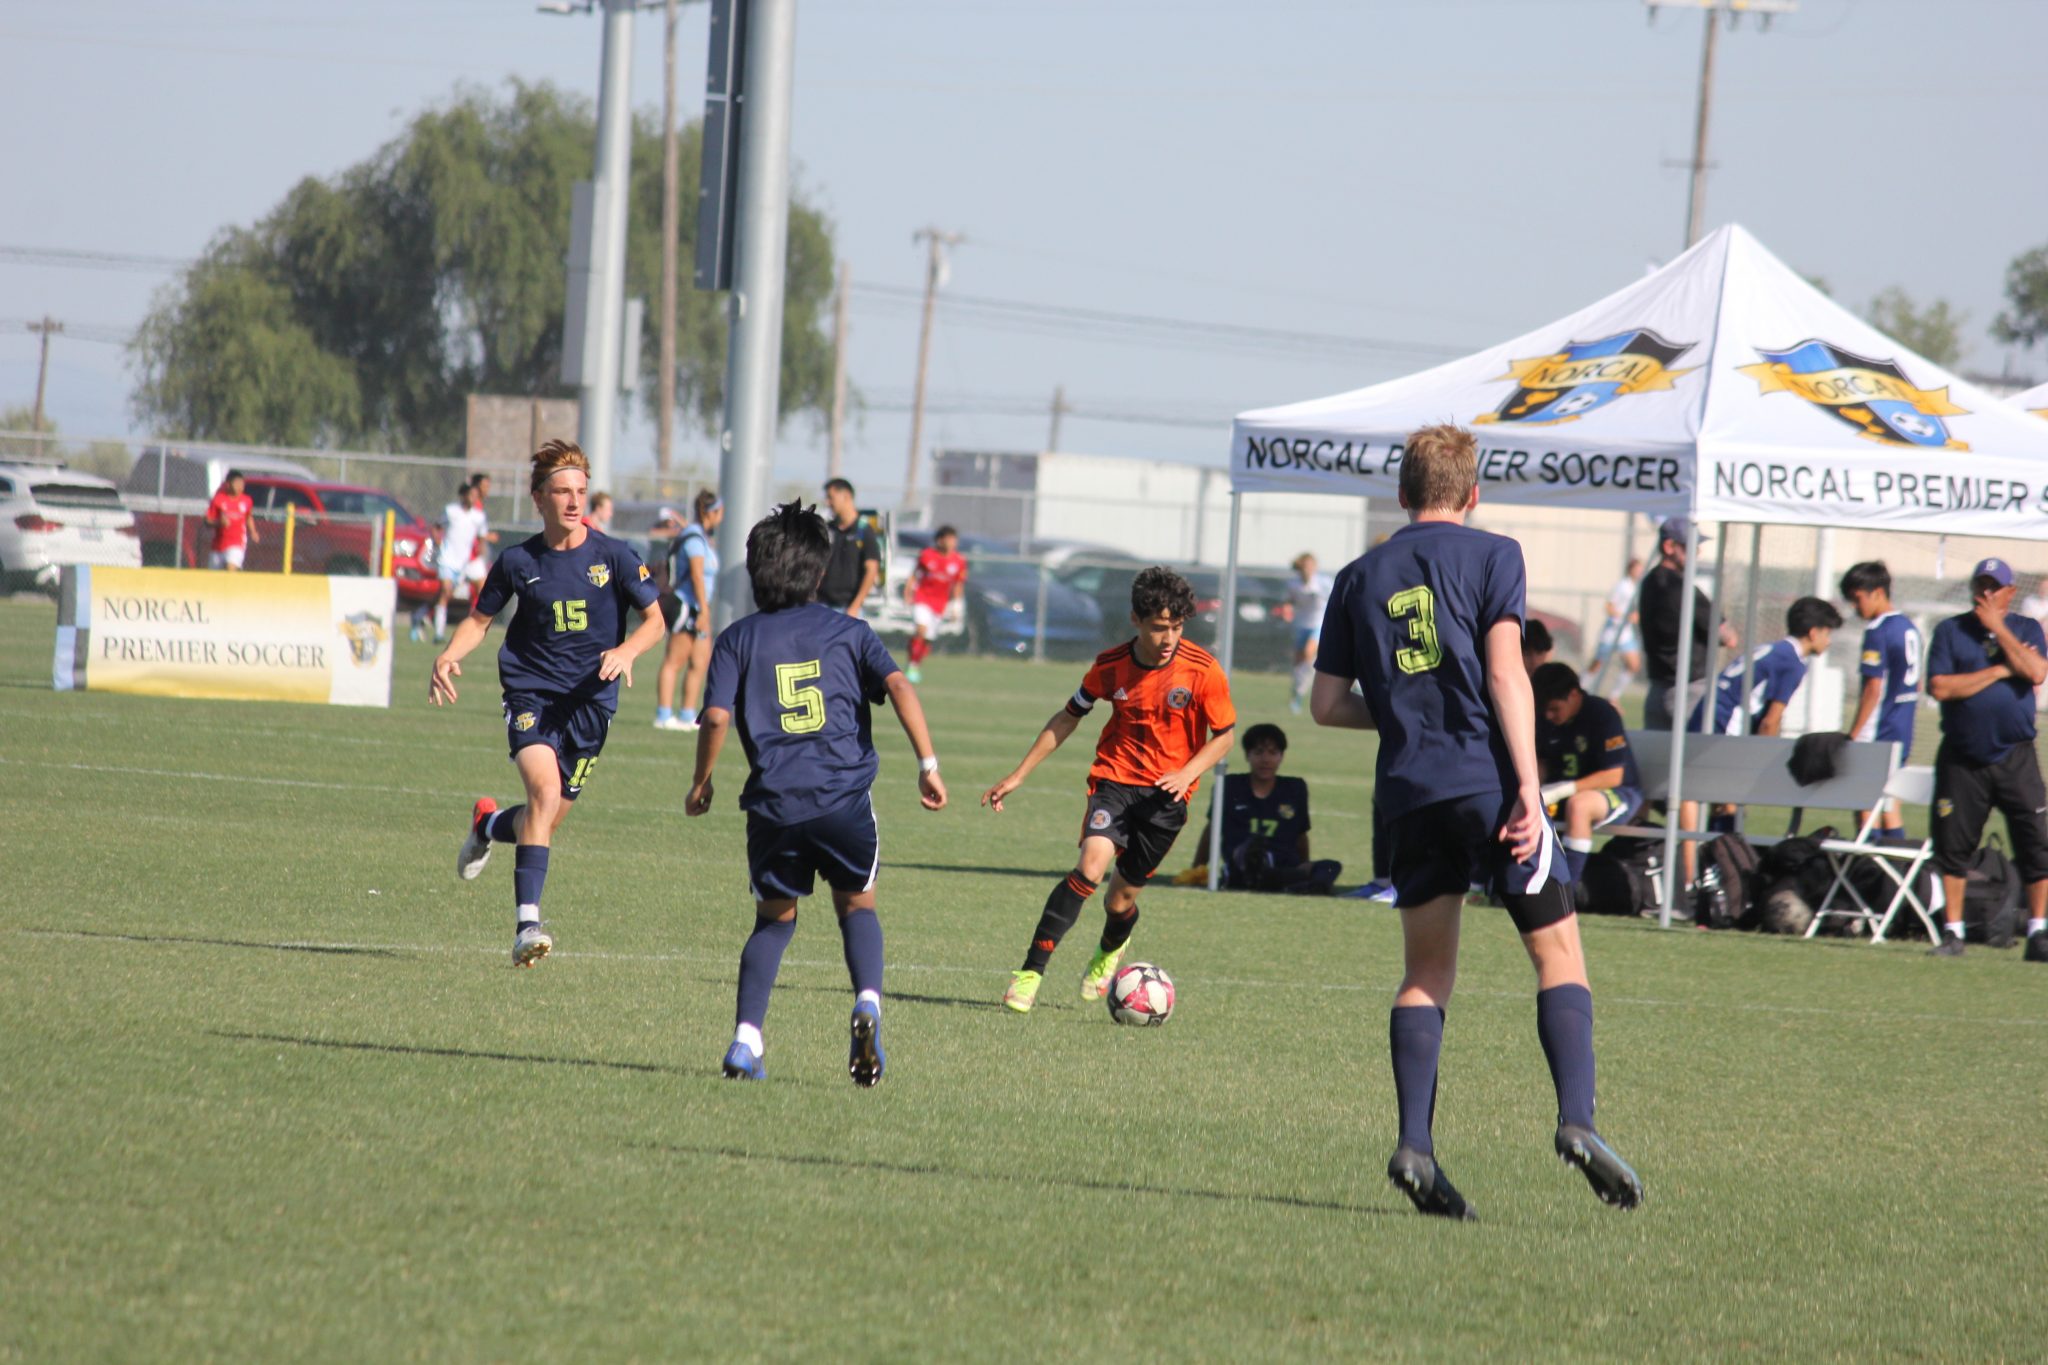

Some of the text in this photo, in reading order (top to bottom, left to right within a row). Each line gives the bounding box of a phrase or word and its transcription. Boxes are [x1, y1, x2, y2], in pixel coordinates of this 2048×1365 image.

[1529, 358, 1650, 384] NORCAL
[1246, 436, 1680, 492] NORCAL PIER SOCCER
[1714, 461, 1864, 502] NORCAL
[1874, 471, 2029, 513] PREMIER
[103, 597, 209, 624] NORCAL
[552, 600, 588, 632] 15
[1388, 585, 1442, 674] 3
[102, 637, 326, 669] PREMIER SOCCER
[1904, 628, 1919, 686] 9
[775, 659, 826, 733] 5
[1249, 818, 1278, 837] 17
